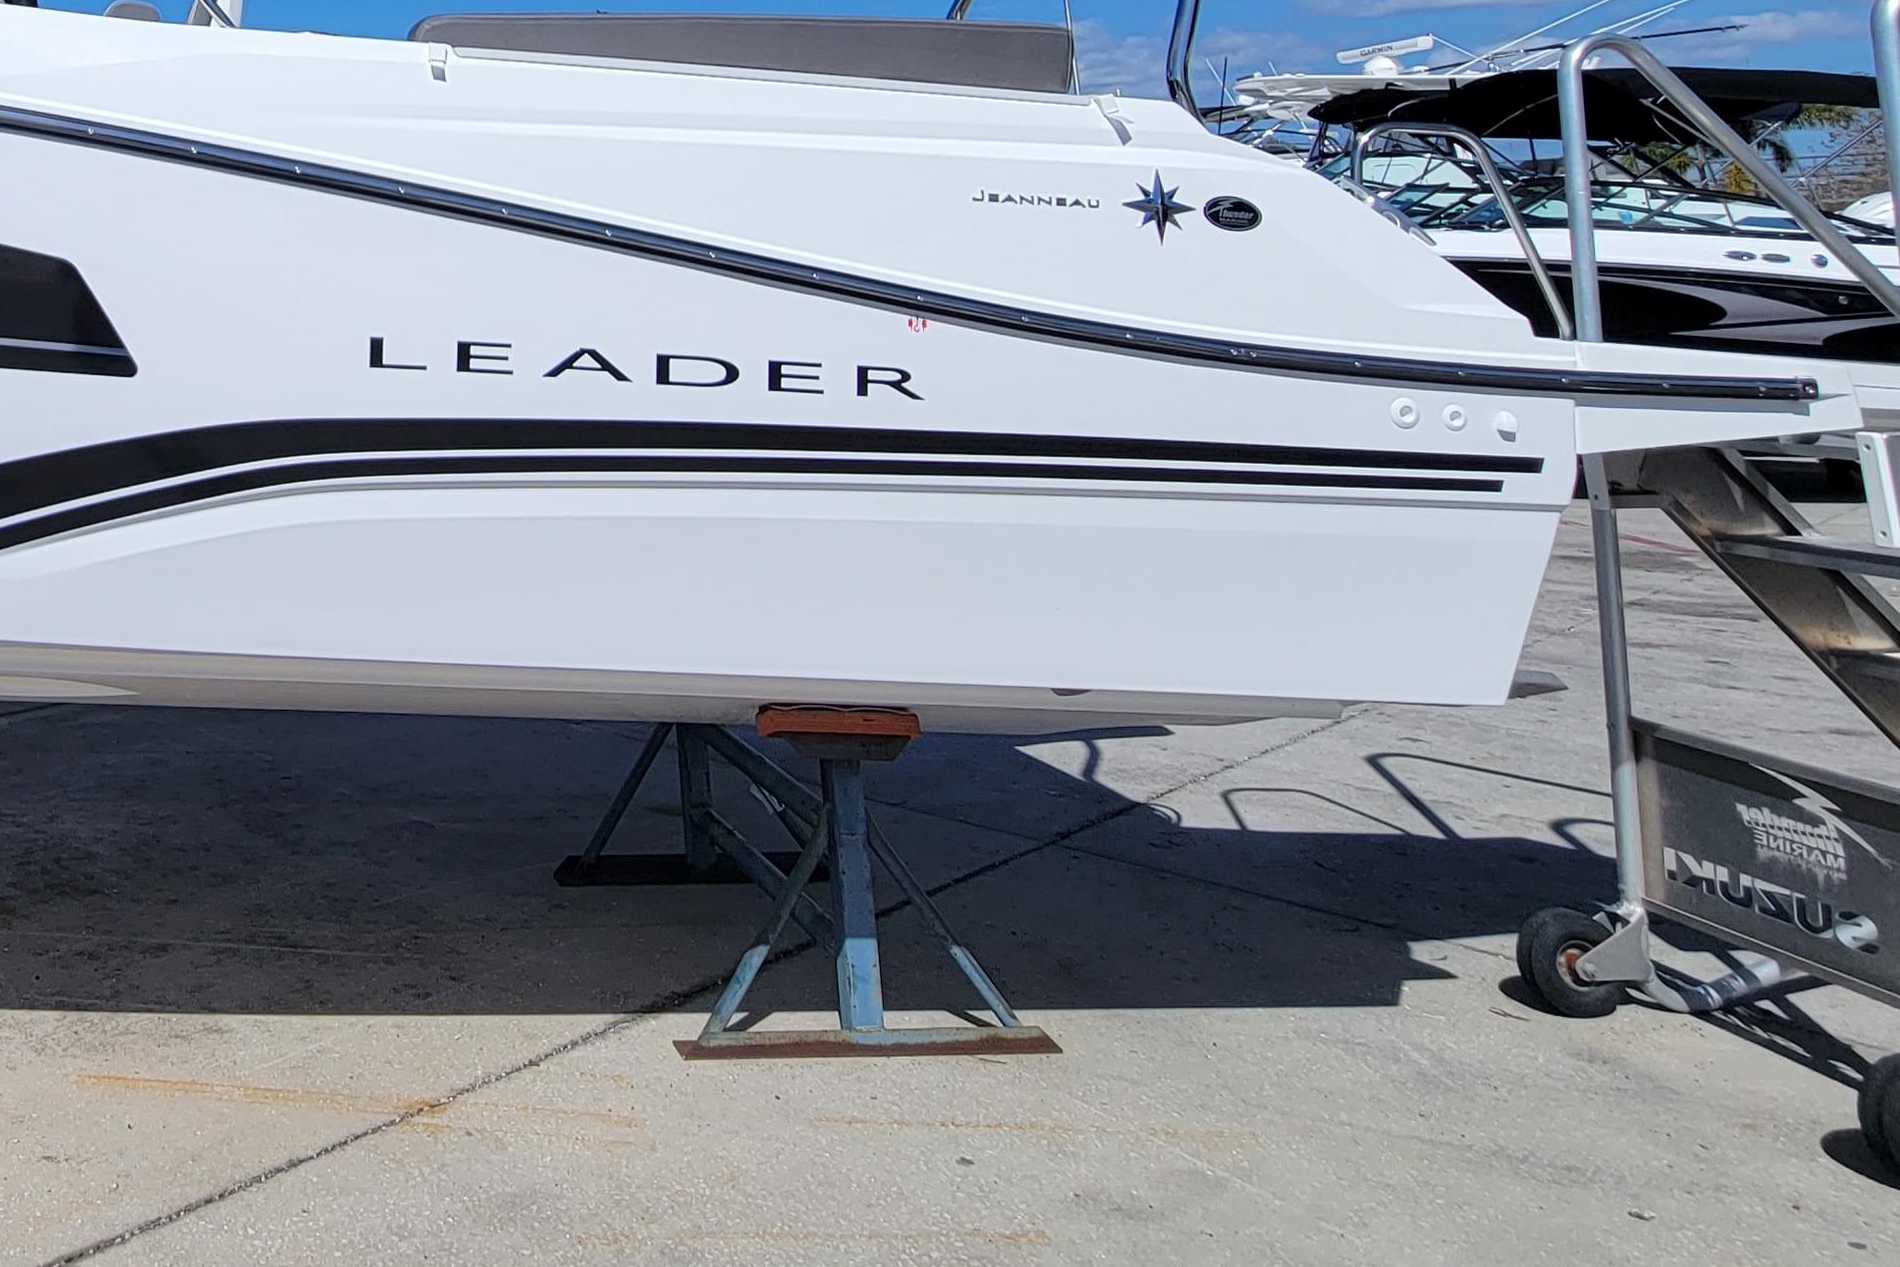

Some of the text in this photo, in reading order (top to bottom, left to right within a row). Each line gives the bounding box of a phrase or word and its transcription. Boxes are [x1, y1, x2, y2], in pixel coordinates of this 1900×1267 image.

[1360, 45, 1394, 56] GARMIN
[972, 189, 1100, 209] JEANNEAU
[369, 336, 925, 401] LEADER
